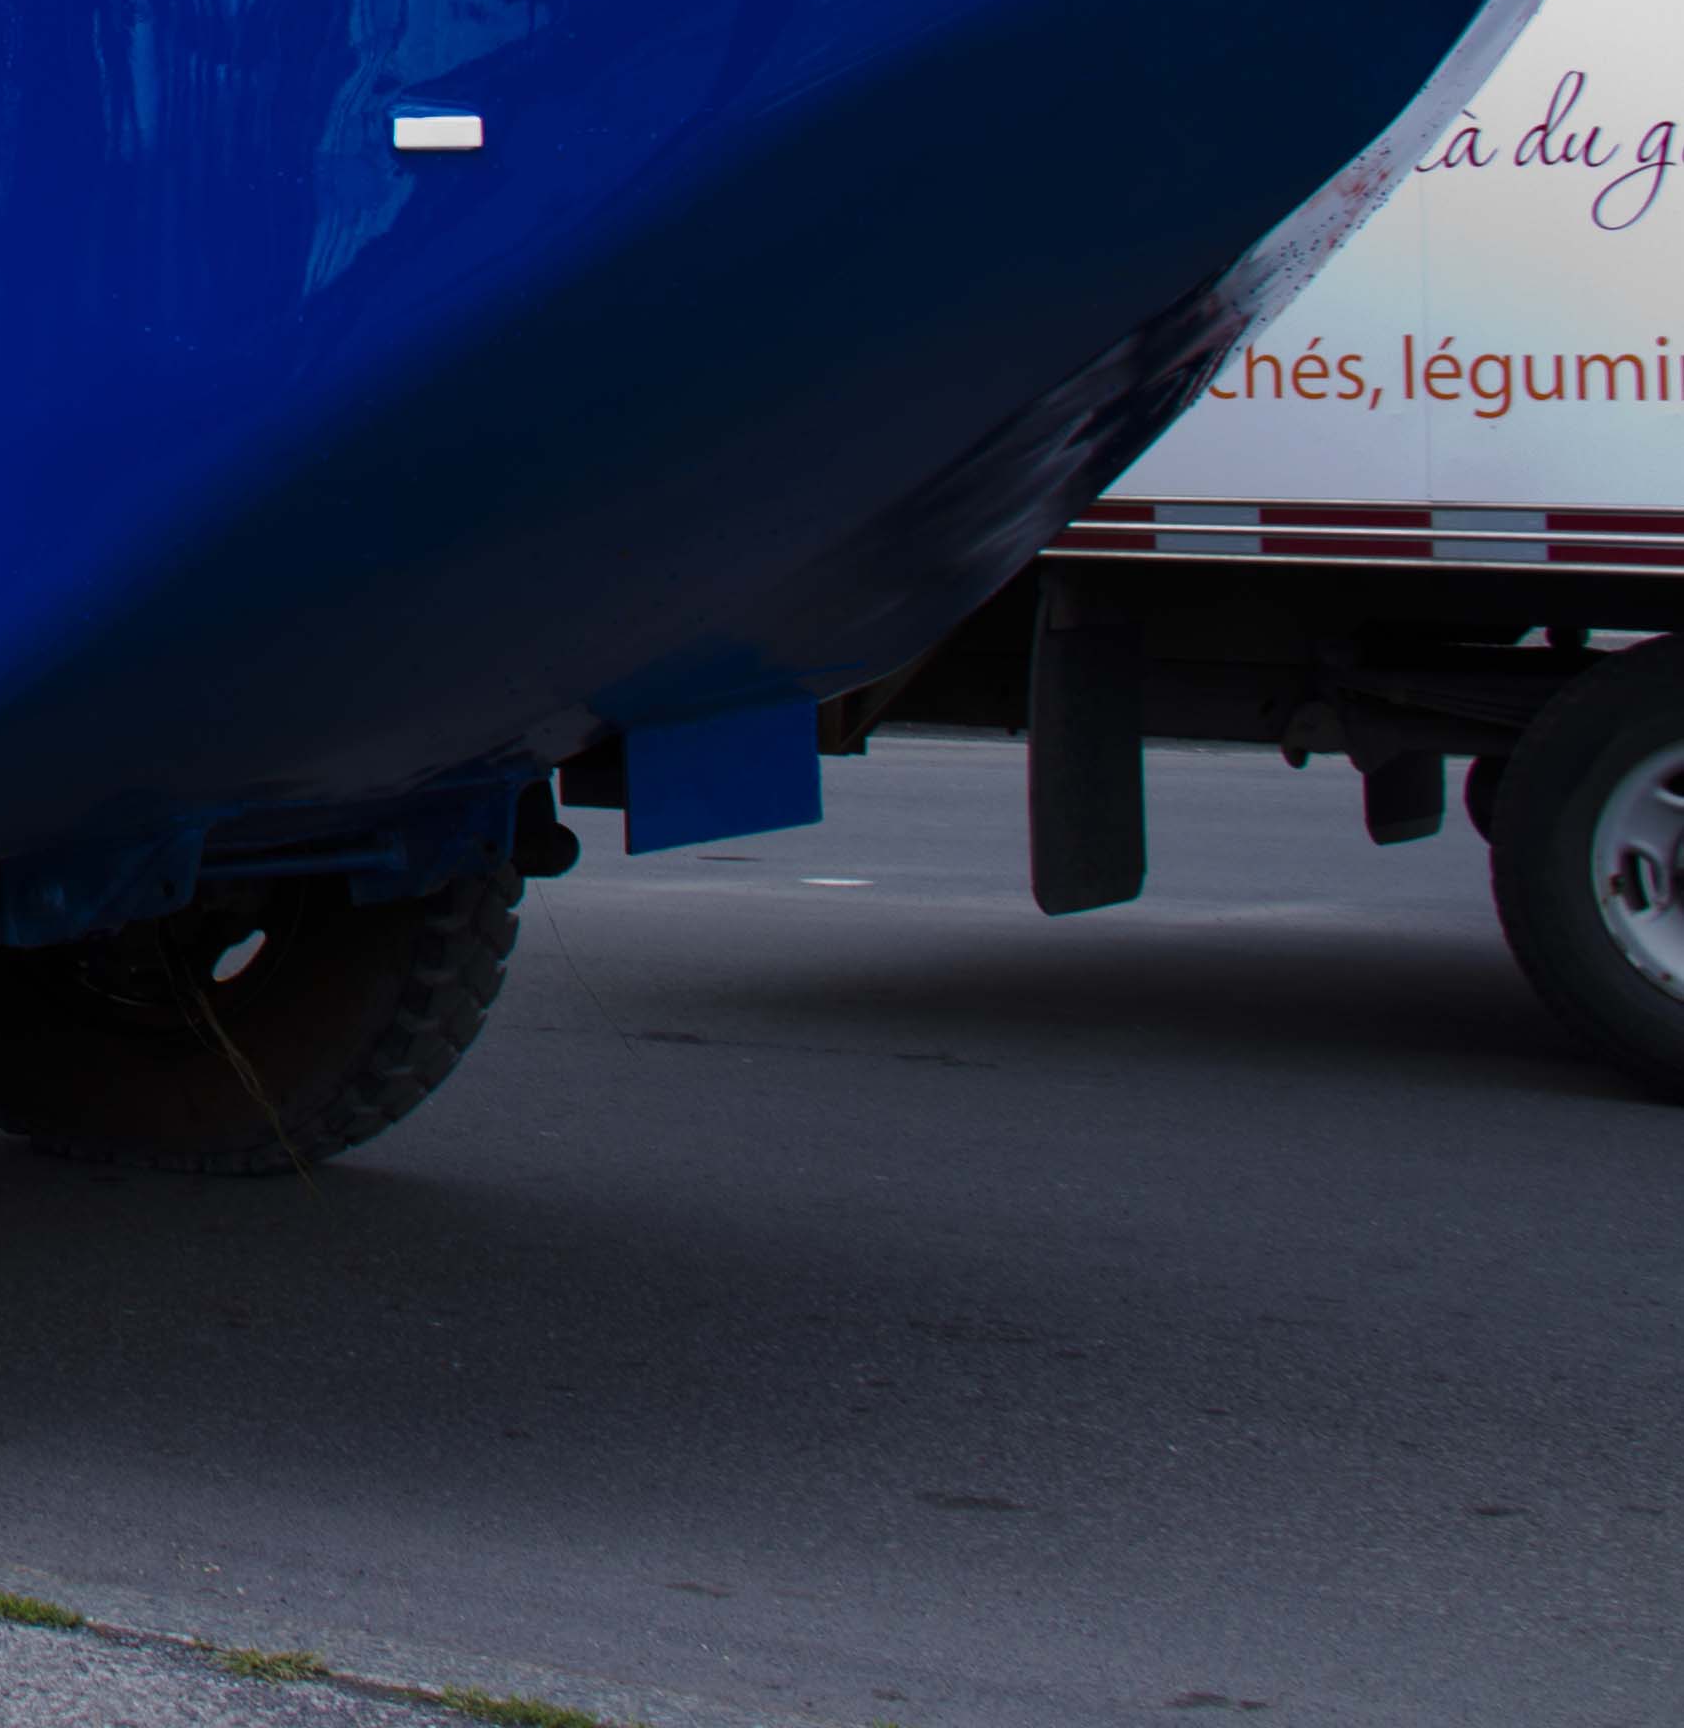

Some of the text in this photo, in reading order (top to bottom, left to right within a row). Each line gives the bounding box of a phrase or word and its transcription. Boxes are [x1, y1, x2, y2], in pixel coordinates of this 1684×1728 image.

[1513, 69, 1621, 169] du
[1590, 120, 1684, 232] g
[1402, 333, 1684, 420] légumi
